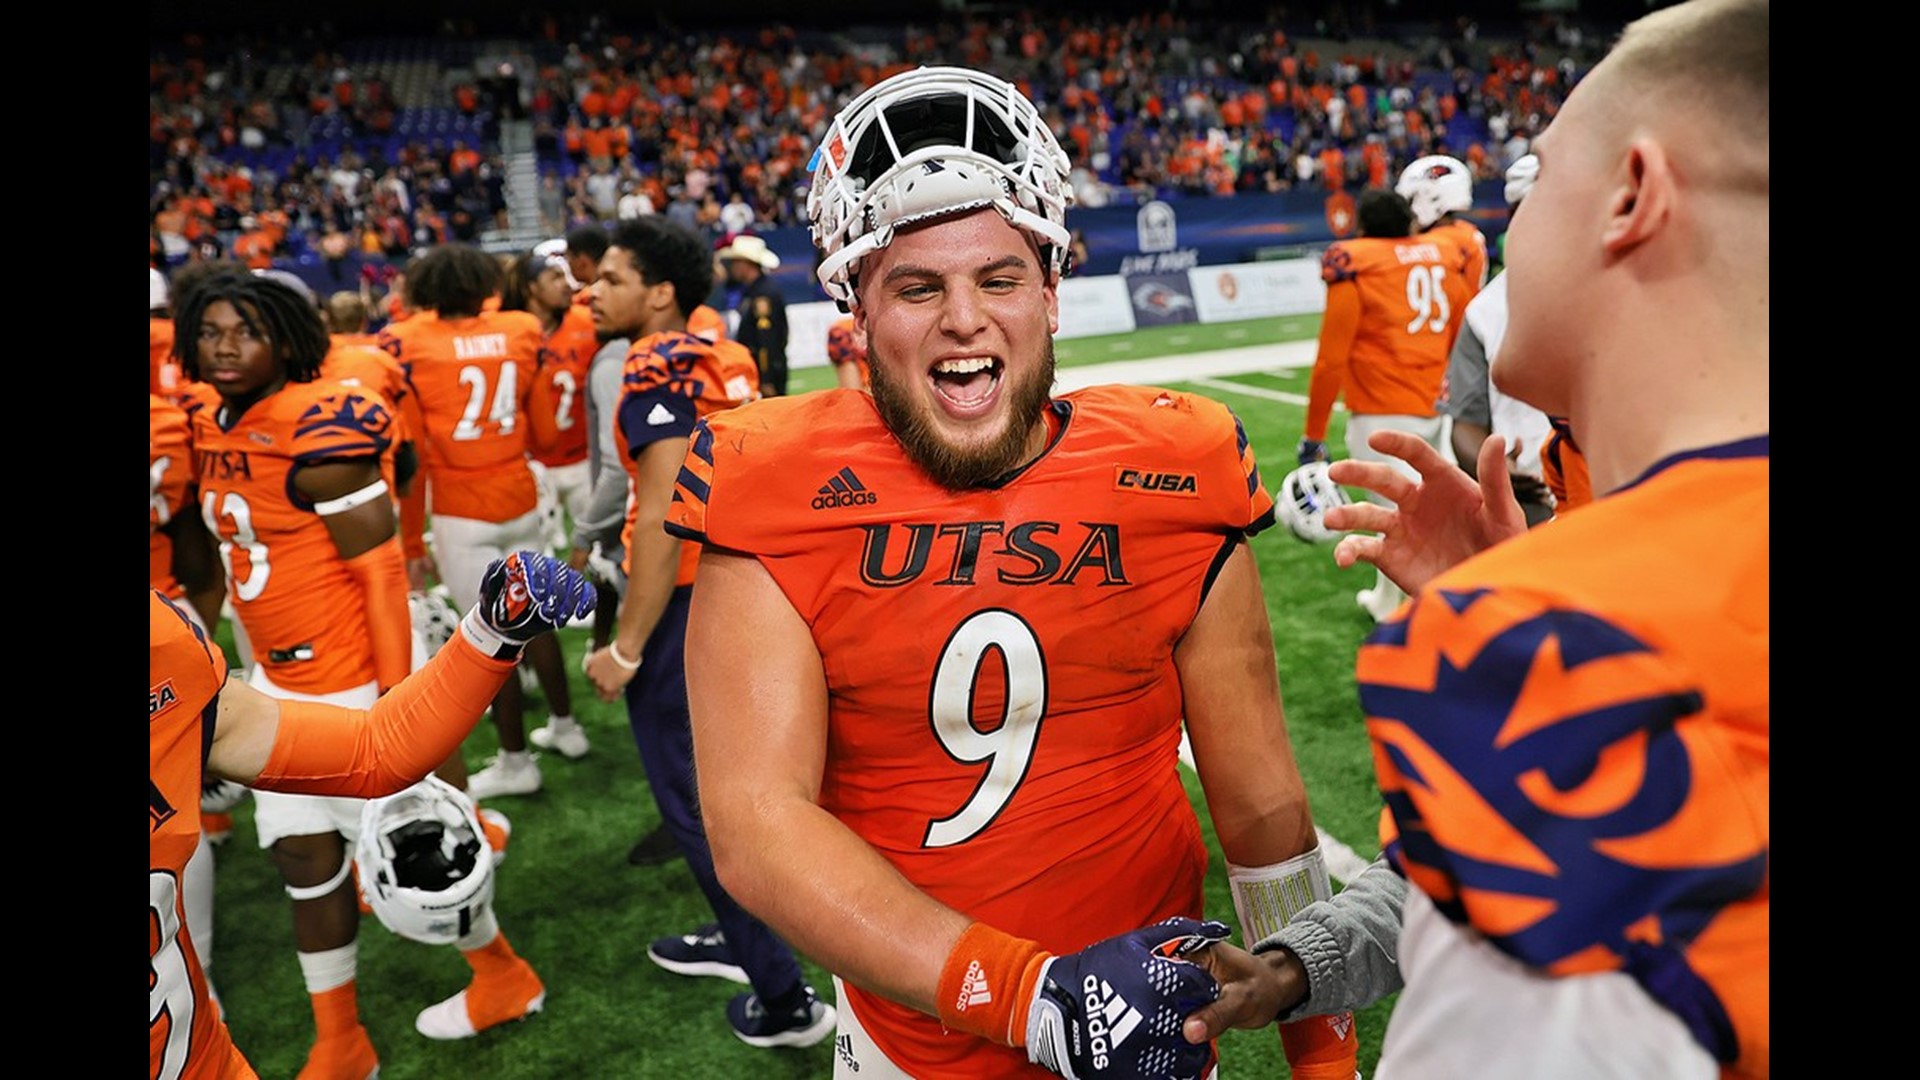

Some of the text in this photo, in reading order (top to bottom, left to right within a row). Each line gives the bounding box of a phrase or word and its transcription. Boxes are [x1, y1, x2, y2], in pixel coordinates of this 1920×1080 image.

[1407, 265, 1450, 333] 95
[452, 360, 517, 441] 24
[811, 491, 877, 510] adidas
[857, 521, 1133, 588] UTSA
[921, 607, 1049, 849] 9
[956, 960, 980, 1012] adidas
[1083, 974, 1109, 1070] adidas
